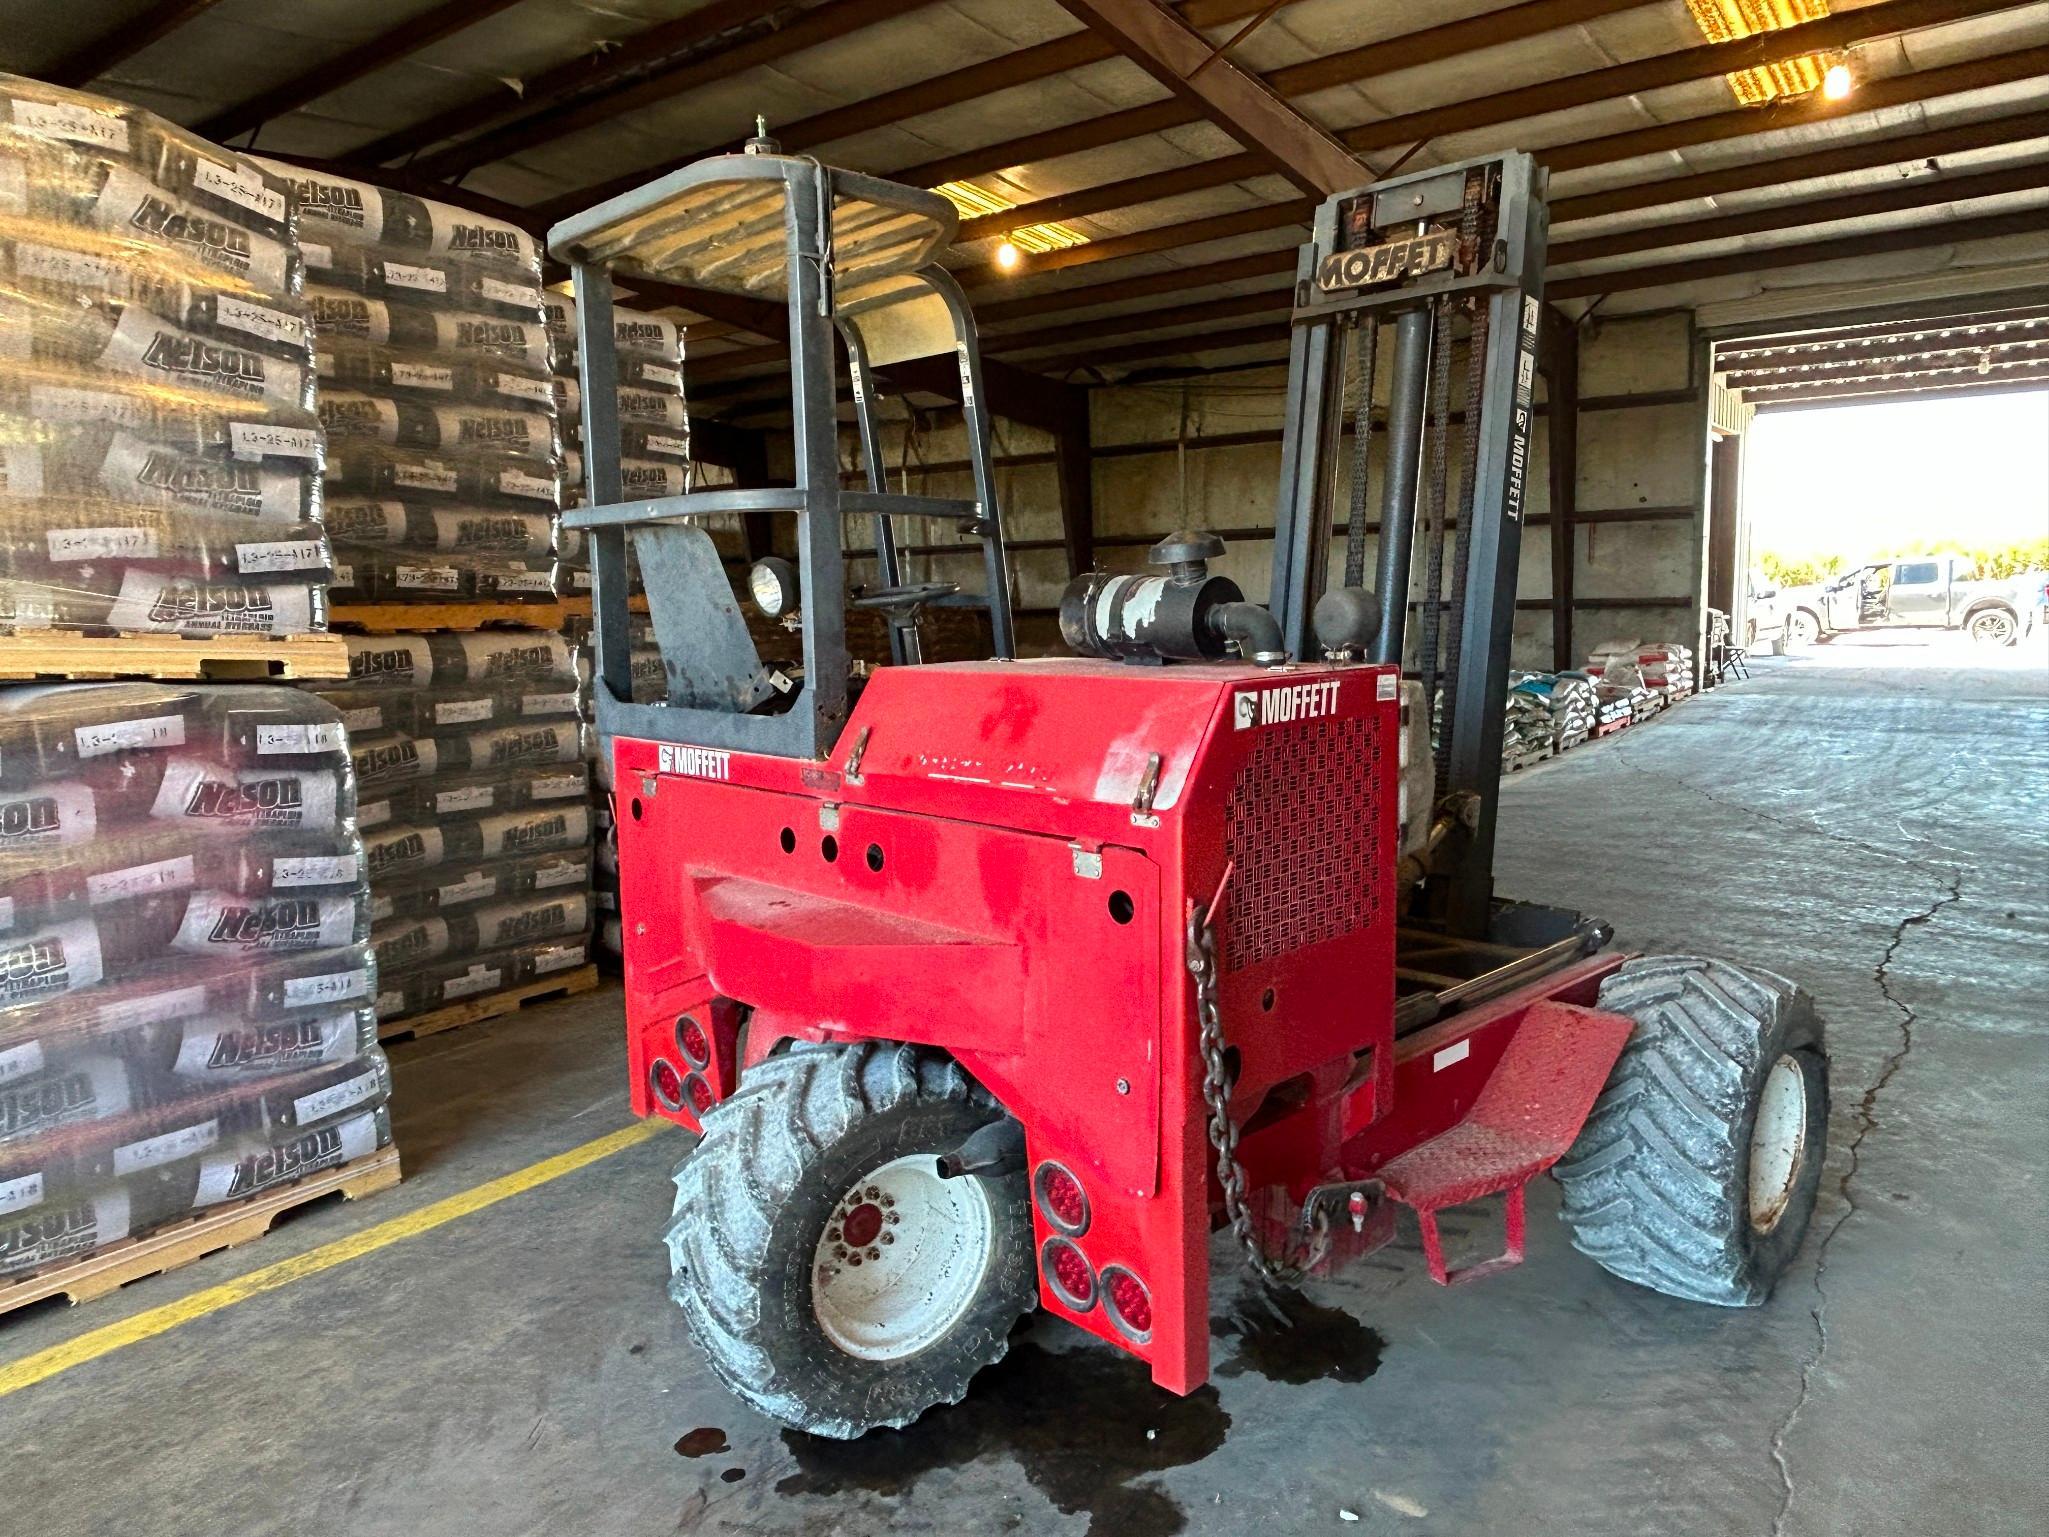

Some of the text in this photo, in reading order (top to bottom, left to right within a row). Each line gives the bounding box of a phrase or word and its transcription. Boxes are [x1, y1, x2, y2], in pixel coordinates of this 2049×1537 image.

[448, 225, 520, 252] Nelson
[1507, 434, 1525, 521] MOFFETT
[348, 649, 413, 679] elson
[1261, 681, 1341, 725] MOFFETT
[352, 741, 419, 778] elson
[674, 747, 730, 780] MOFFETT
[227, 1126, 342, 1197] Nelson
